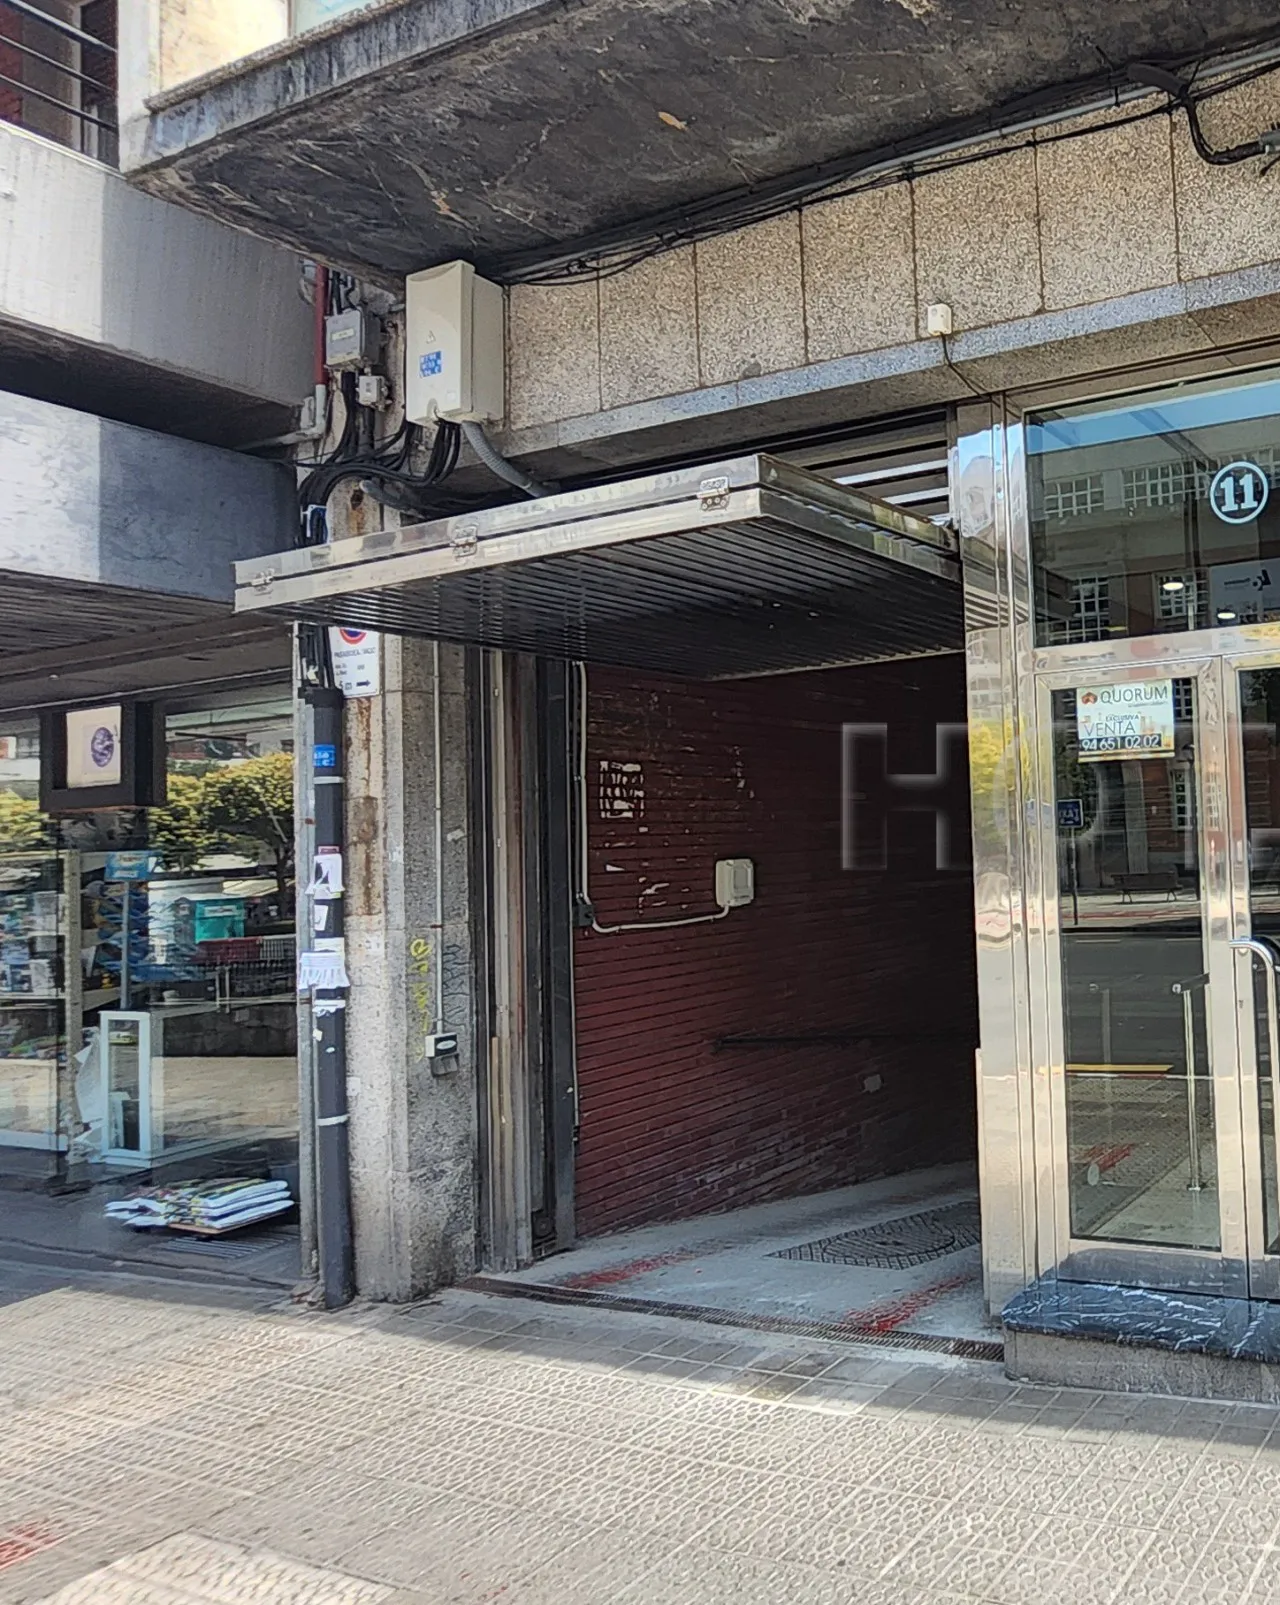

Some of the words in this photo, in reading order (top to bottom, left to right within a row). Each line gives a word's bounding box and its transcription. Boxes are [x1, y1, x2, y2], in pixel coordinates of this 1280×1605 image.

[1220, 473, 1258, 512] 11
[1101, 686, 1167, 704] QUORUM
[1084, 721, 1135, 736] VENTA
[1081, 739, 1098, 751] 94
[1100, 738, 1121, 750] 651
[1125, 736, 1141, 749] 02
[1143, 735, 1159, 748] 02
